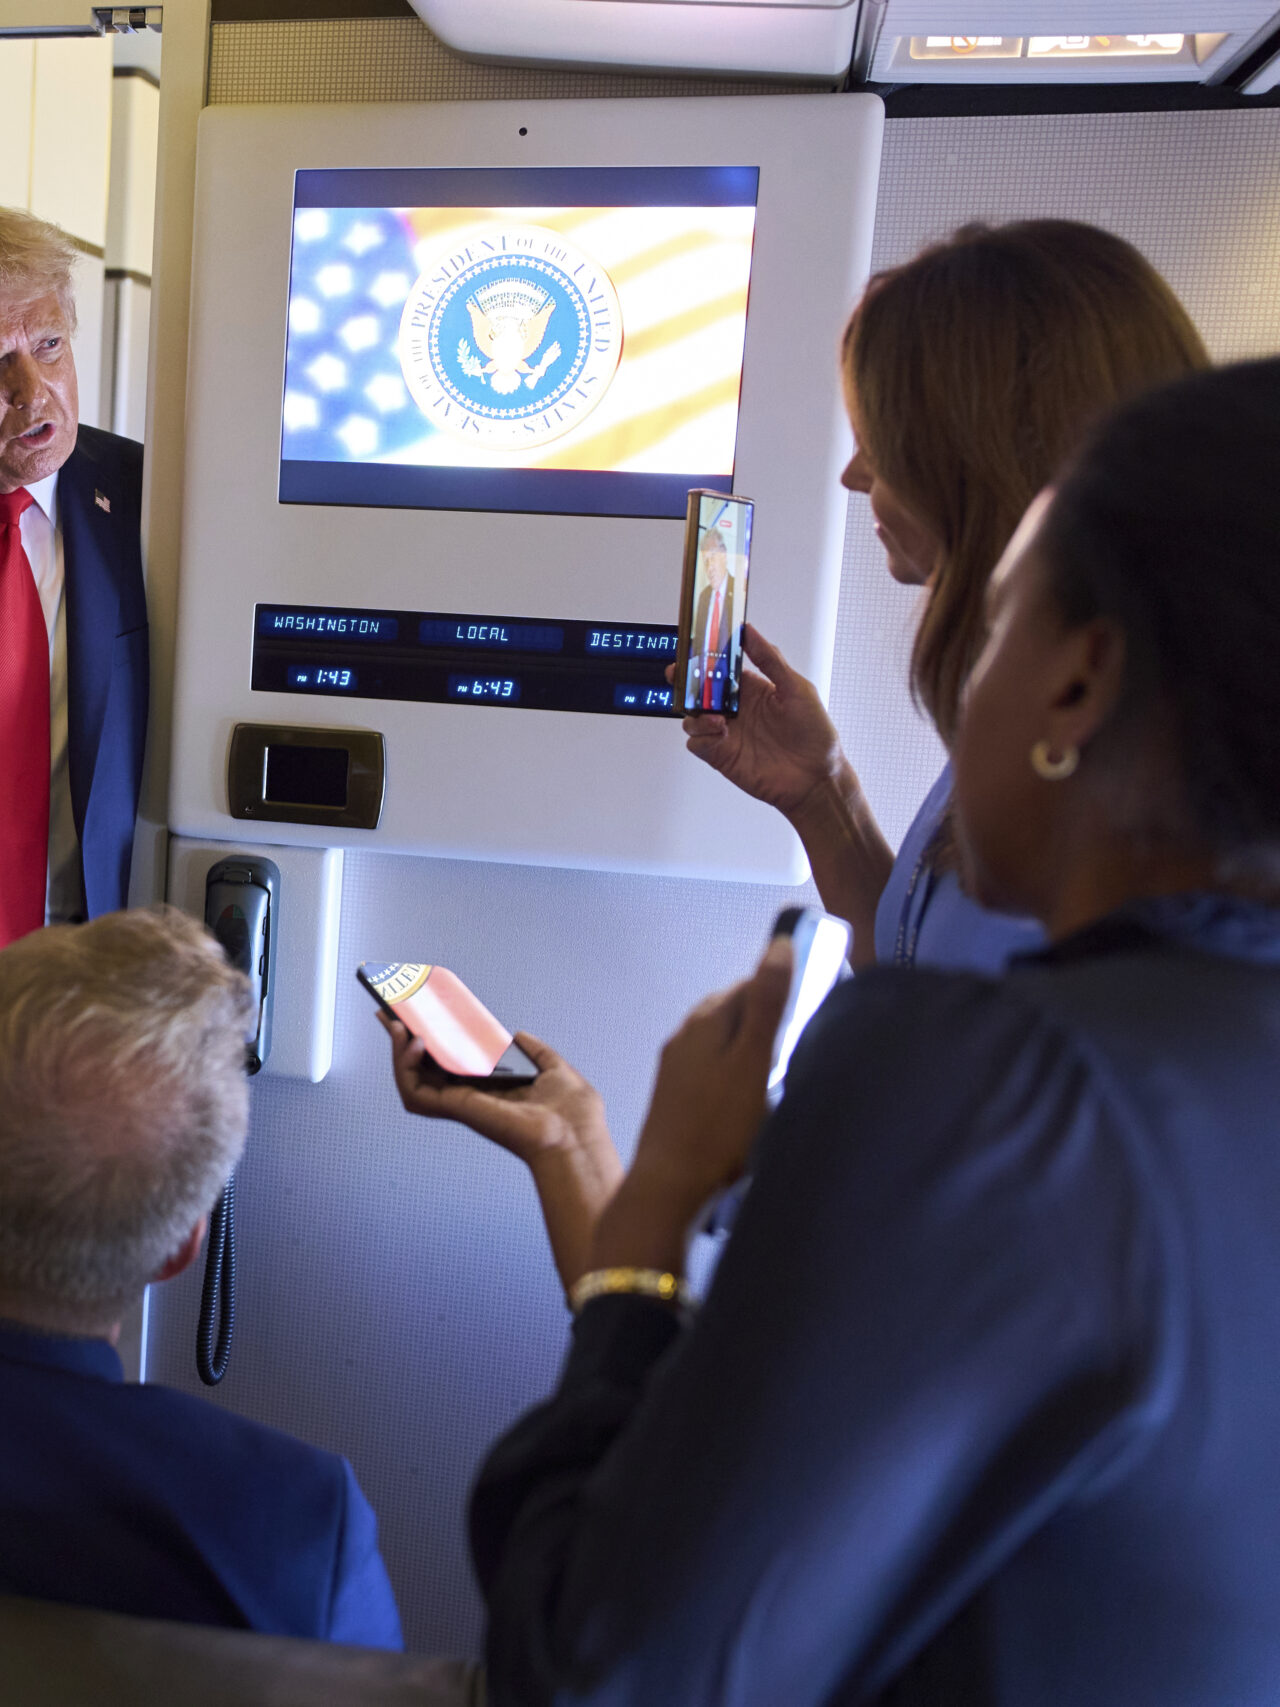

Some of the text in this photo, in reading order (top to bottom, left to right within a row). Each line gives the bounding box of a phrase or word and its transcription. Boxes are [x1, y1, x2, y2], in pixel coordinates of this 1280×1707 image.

[273, 615, 381, 634] WASHINGTON
[456, 625, 509, 642] LOCAL
[590, 632, 679, 650] DESTINAT
[296, 669, 352, 686] PM 1:43
[457, 680, 514, 697] PM 6:43
[624, 689, 674, 706] PM 1:4
